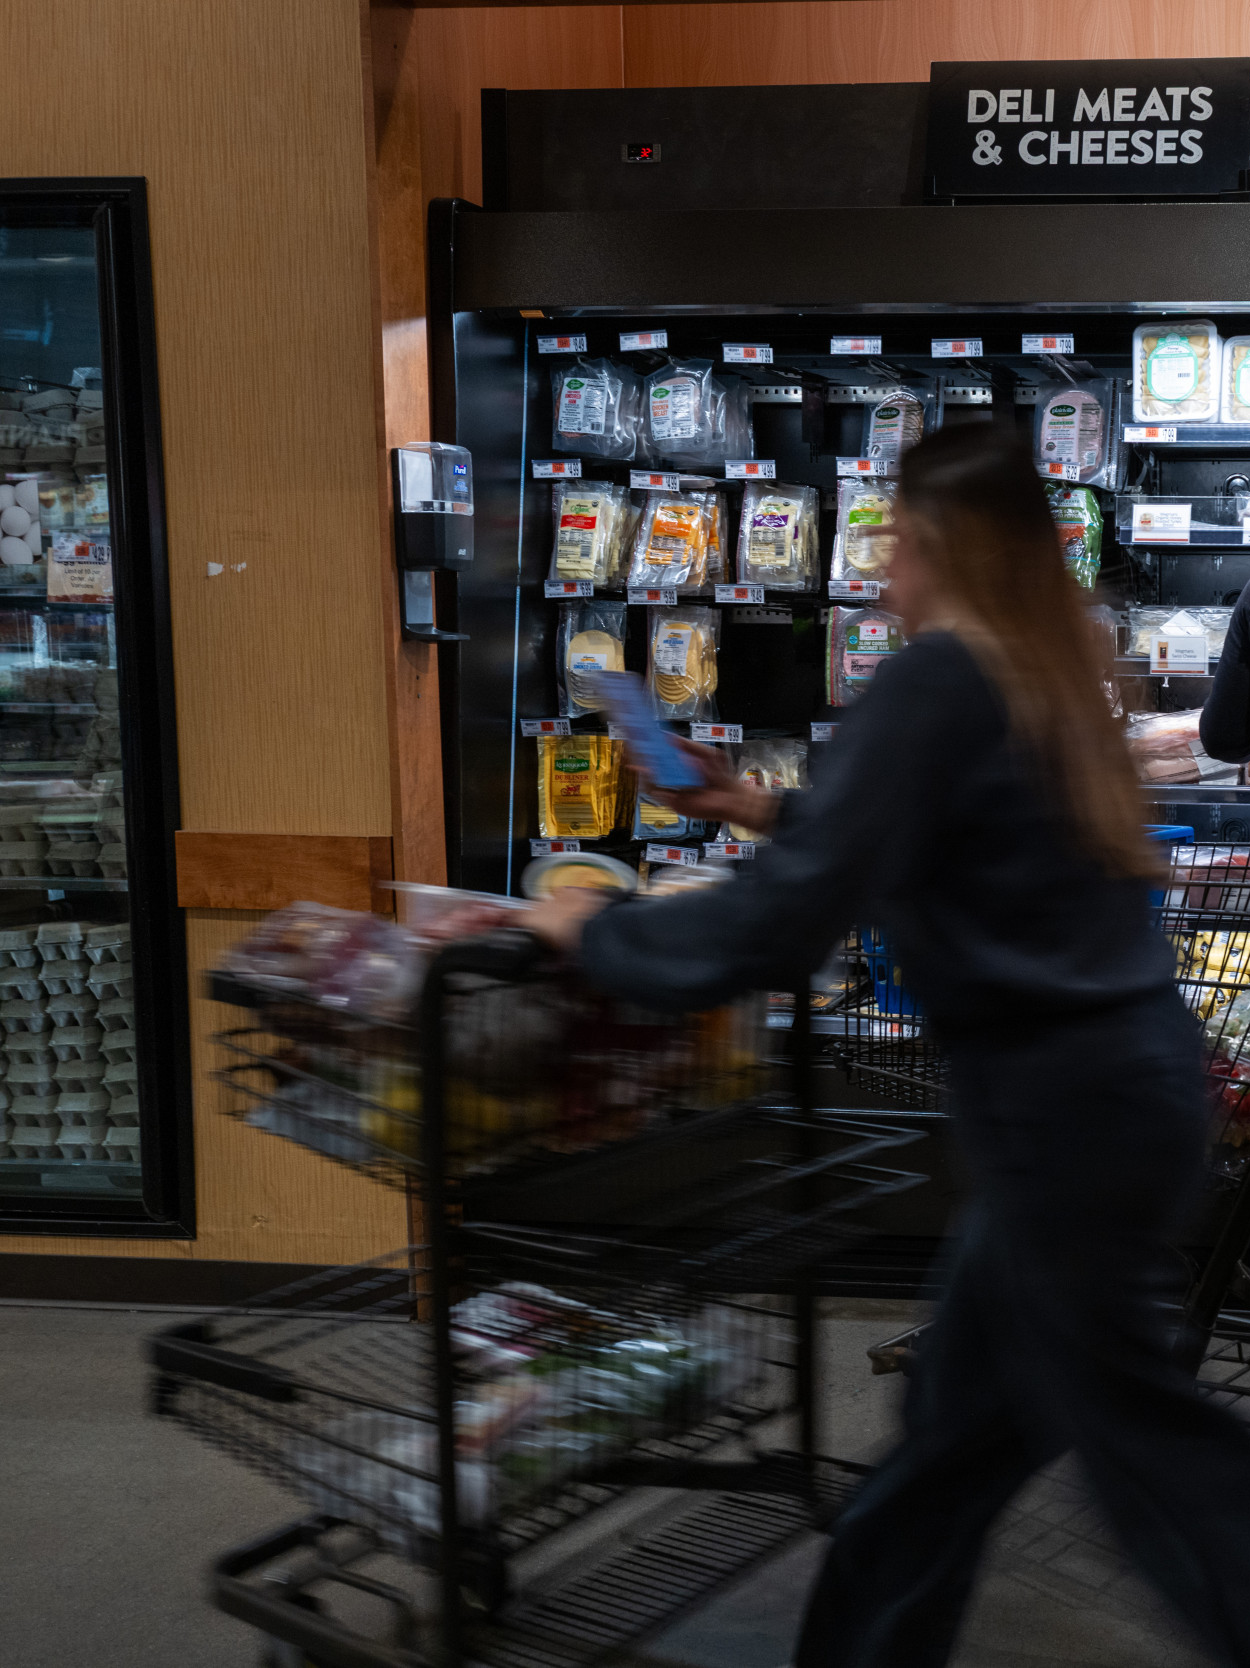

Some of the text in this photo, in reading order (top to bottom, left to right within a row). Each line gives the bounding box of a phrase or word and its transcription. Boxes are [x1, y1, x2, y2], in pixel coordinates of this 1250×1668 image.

[967, 86, 1213, 123] DELI MEATS
[972, 129, 1203, 166] & CHEESES
